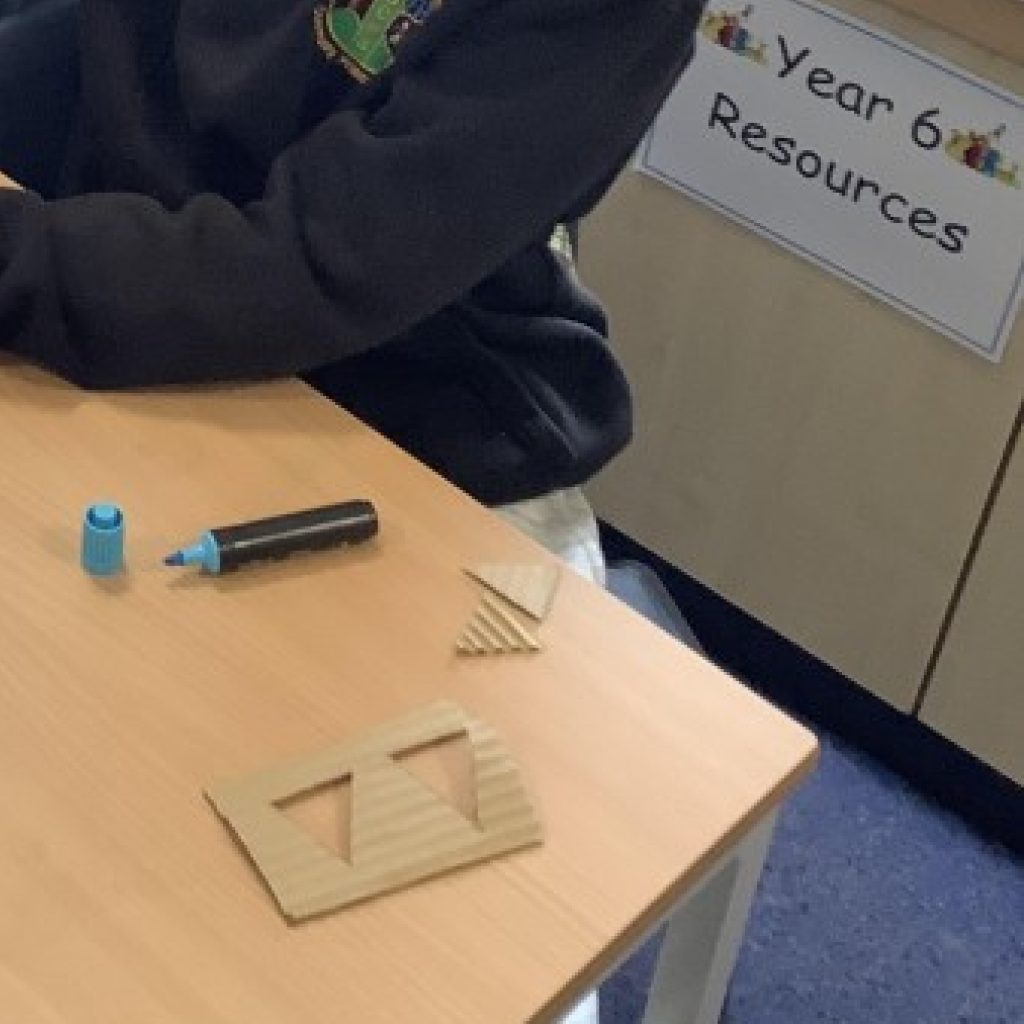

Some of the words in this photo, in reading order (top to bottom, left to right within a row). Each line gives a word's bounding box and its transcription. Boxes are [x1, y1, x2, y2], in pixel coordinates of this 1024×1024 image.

[777, 34, 894, 120] Year
[911, 108, 942, 150] 6
[708, 92, 969, 254] Resources
